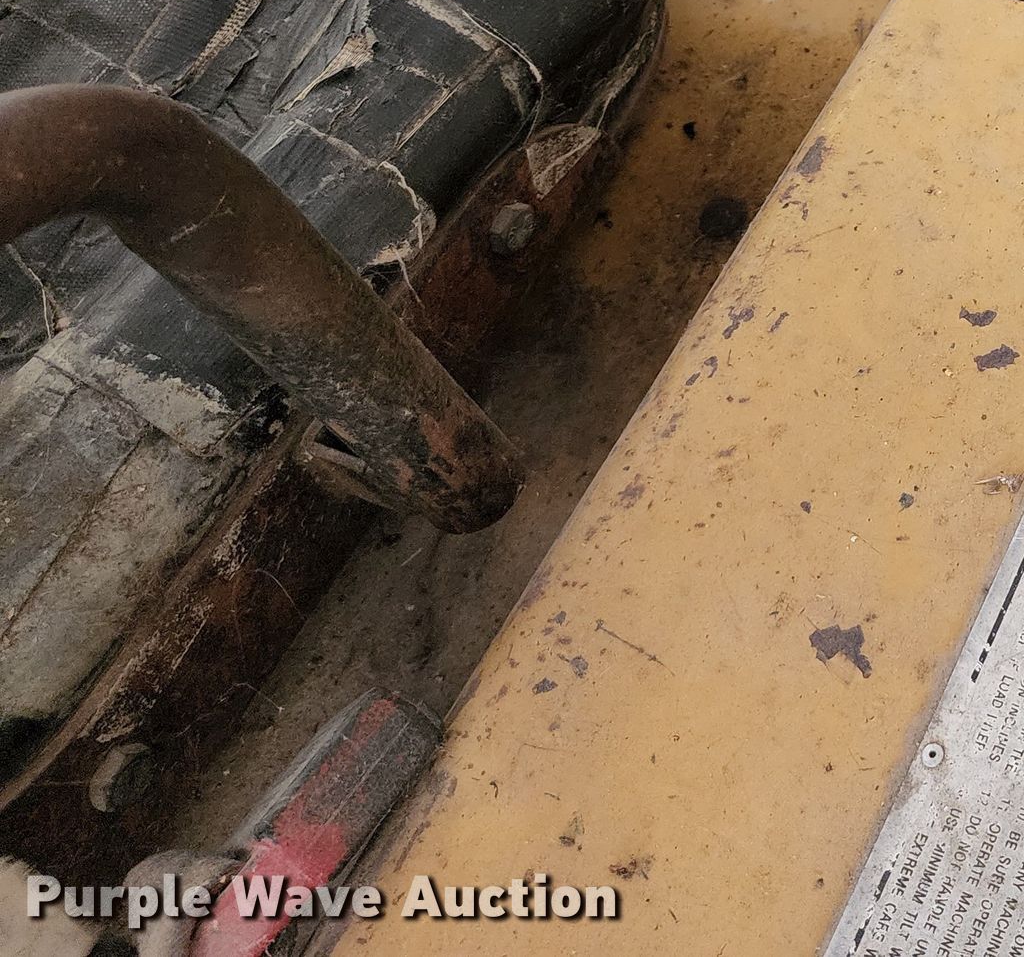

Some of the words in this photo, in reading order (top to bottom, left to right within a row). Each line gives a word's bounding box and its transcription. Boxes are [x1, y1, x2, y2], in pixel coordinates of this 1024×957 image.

[989, 674, 1013, 709] LOAD
[940, 806, 961, 835] USE
[963, 814, 981, 836] DO
[948, 840, 970, 871] NOT
[965, 822, 1001, 887] OPERATE
[1004, 830, 1021, 850] BE
[890, 832, 928, 897] EXTREME
[911, 840, 947, 904] MINIMUM
[986, 854, 1011, 893] SURE
[922, 875, 956, 933] HANDLE
[895, 909, 918, 940] TILT
